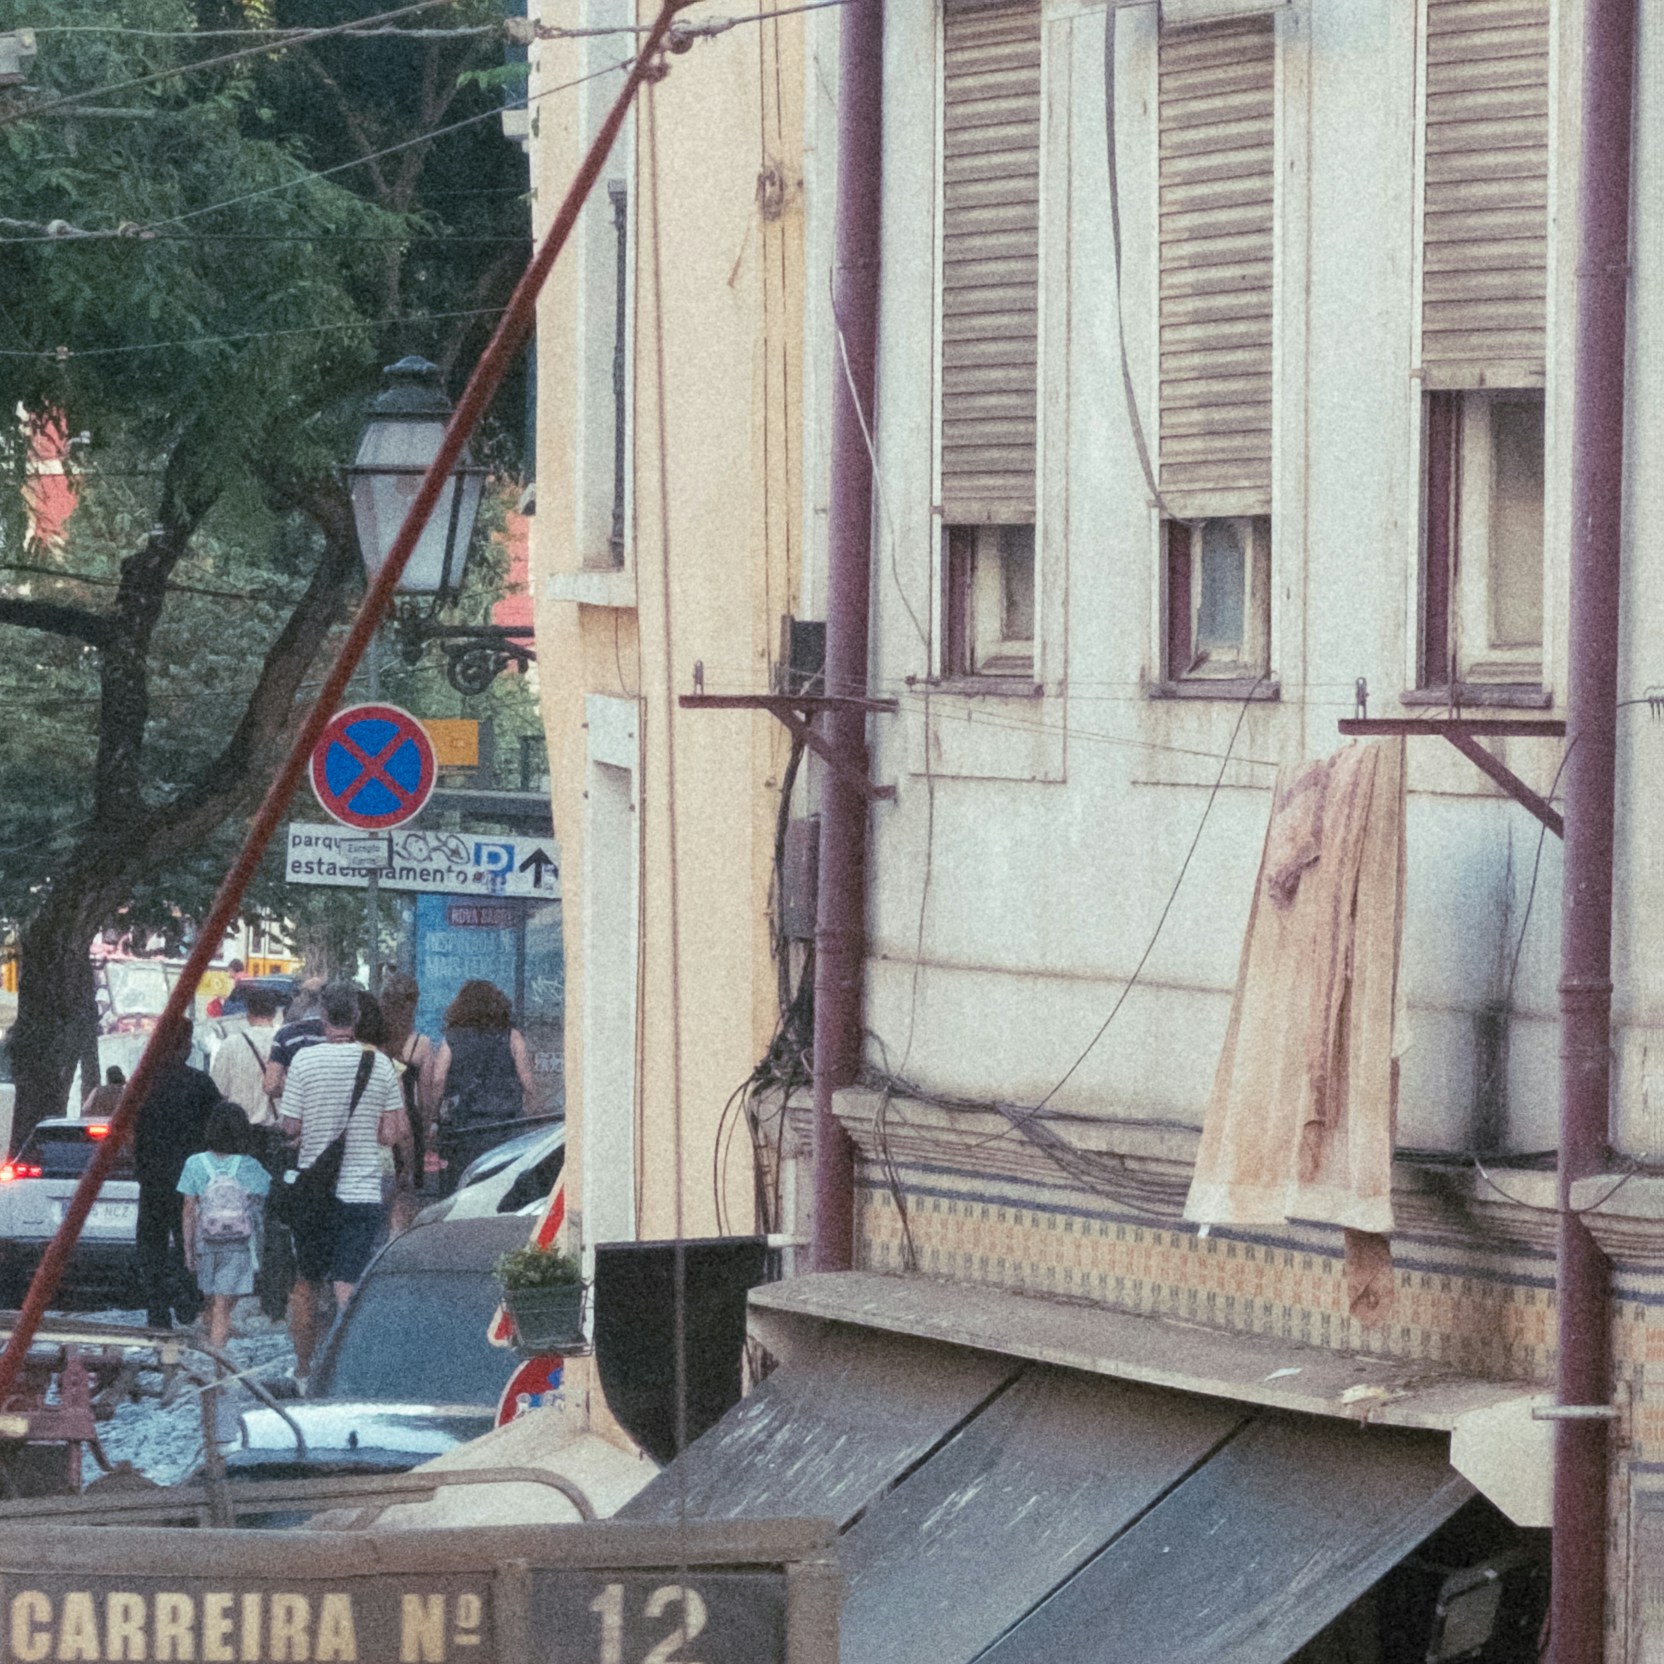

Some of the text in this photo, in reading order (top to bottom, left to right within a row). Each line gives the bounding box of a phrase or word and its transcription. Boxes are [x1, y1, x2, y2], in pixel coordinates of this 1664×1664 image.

[291, 832, 340, 850] parqu
[290, 857, 468, 885] estacioamento
[10, 1590, 357, 1662] CARREIRA
[399, 1591, 483, 1664] Nº
